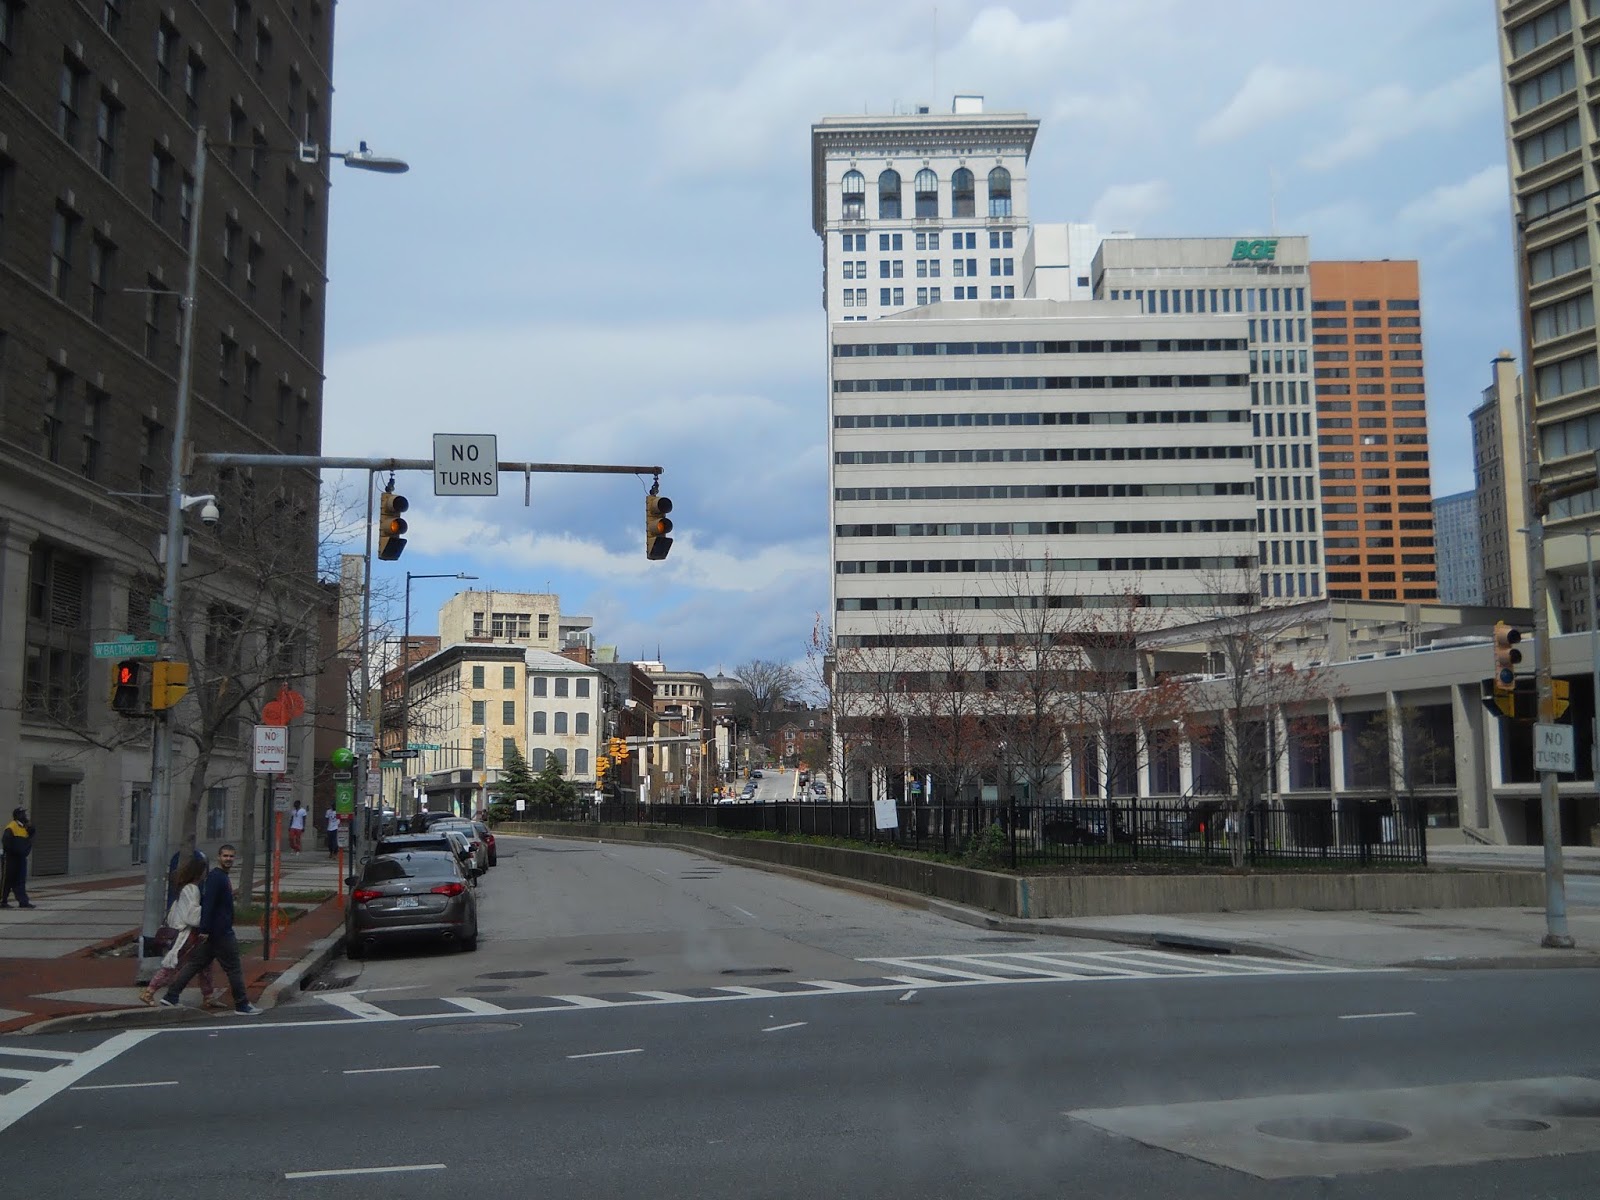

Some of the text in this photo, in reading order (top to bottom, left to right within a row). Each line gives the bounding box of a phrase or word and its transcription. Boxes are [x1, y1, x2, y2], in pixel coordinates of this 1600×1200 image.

[1232, 240, 1278, 261] BGE
[451, 444, 479, 461] NO
[439, 471, 493, 486] TURNS
[95, 645, 103, 655] W
[103, 643, 145, 656] BALTIMORE
[265, 731, 277, 741] NO
[1545, 732, 1562, 746] NO
[256, 745, 285, 754] STOPPING
[1536, 750, 1571, 764] TURNS
